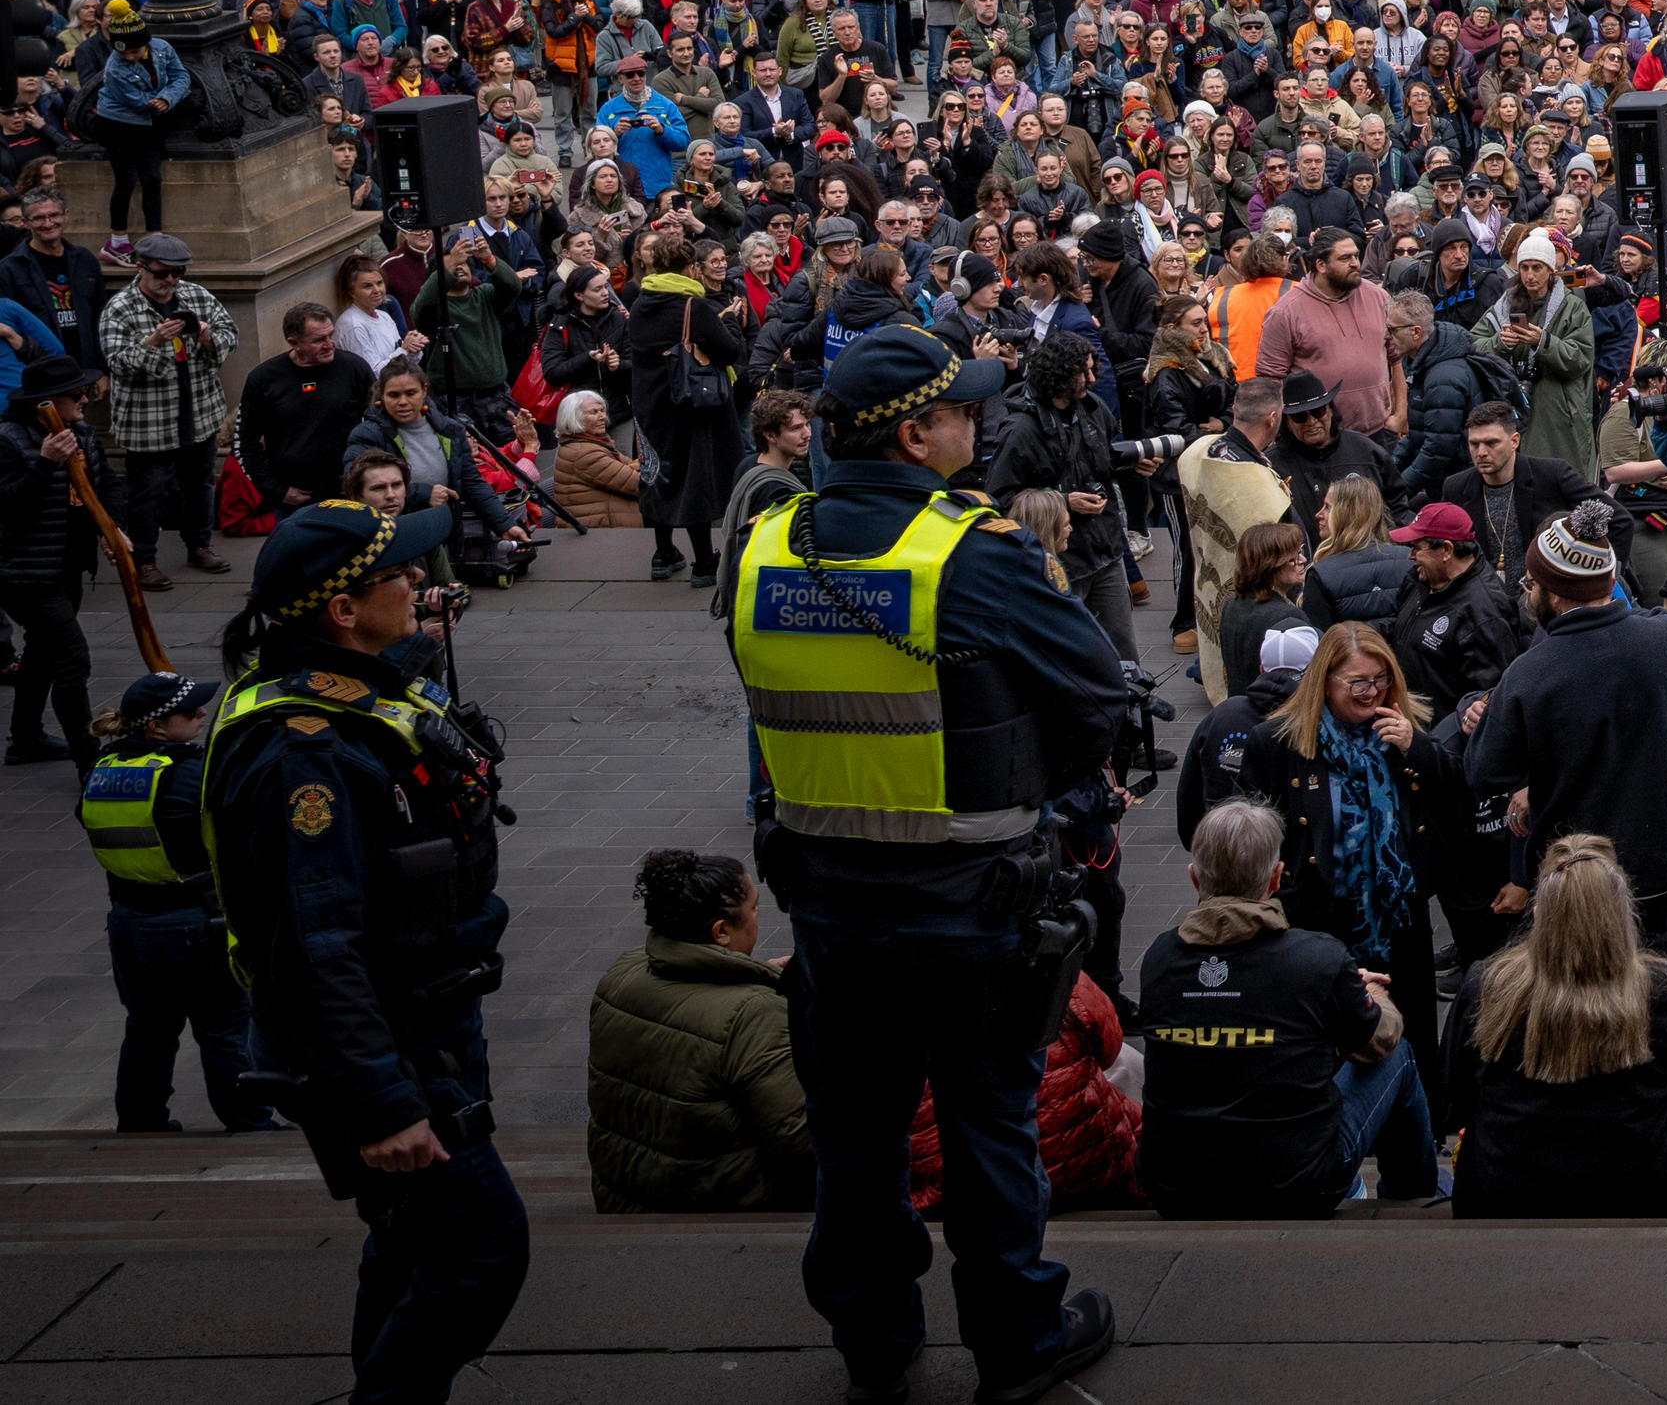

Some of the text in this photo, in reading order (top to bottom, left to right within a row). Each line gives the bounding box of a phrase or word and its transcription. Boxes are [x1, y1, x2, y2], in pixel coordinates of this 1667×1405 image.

[1544, 527, 1605, 571] HONOUR
[835, 575, 866, 584] Police
[88, 770, 146, 795] Police
[1476, 818, 1502, 834] WALK
[1155, 1028, 1275, 1048] TRUTH
